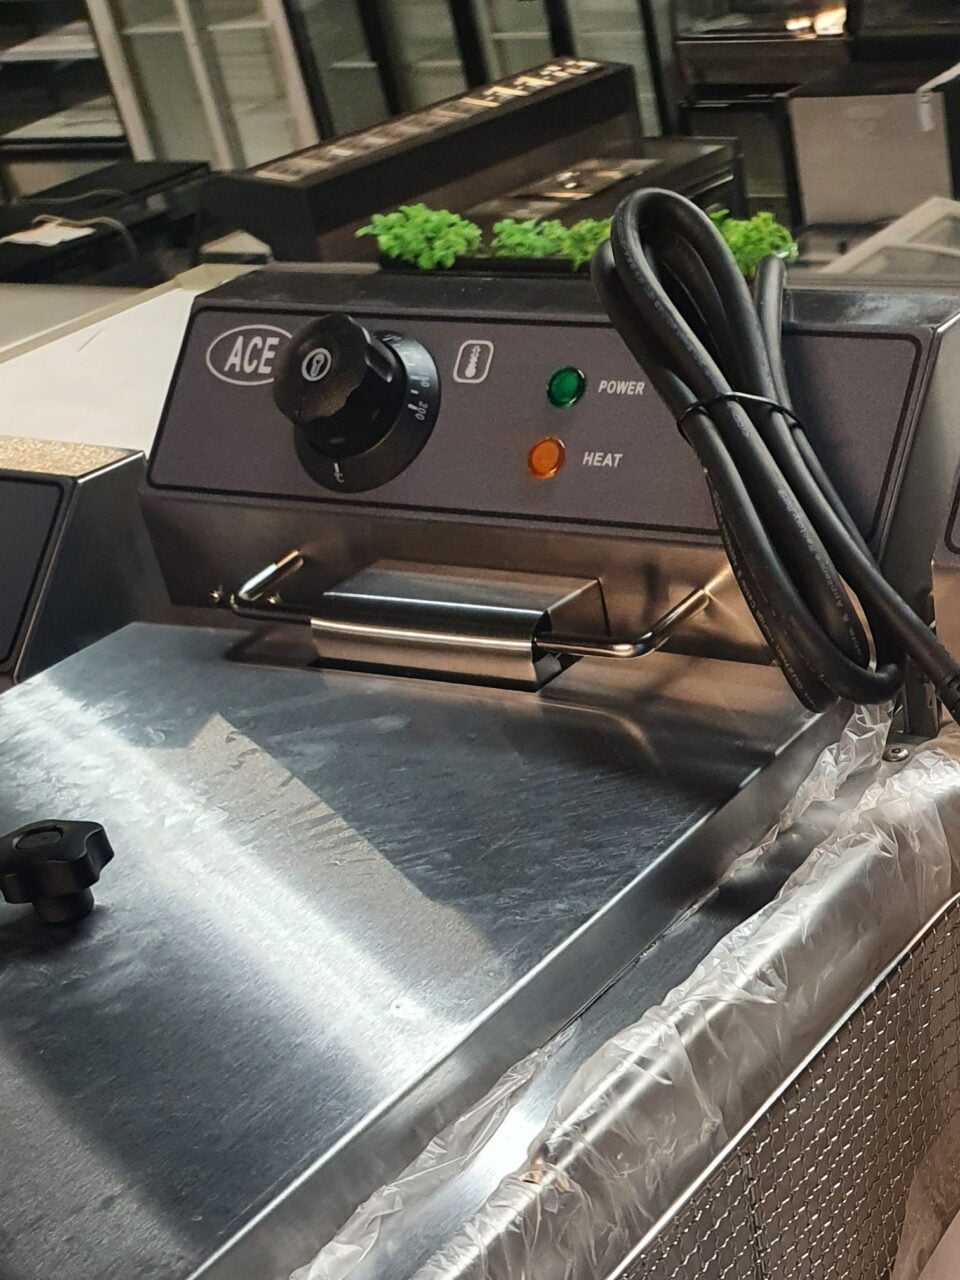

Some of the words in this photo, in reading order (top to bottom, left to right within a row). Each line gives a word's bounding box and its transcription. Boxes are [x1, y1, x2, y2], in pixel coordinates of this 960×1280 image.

[224, 335, 280, 374] ACE
[598, 380, 645, 396] POWER
[582, 451, 624, 467] HEAT
